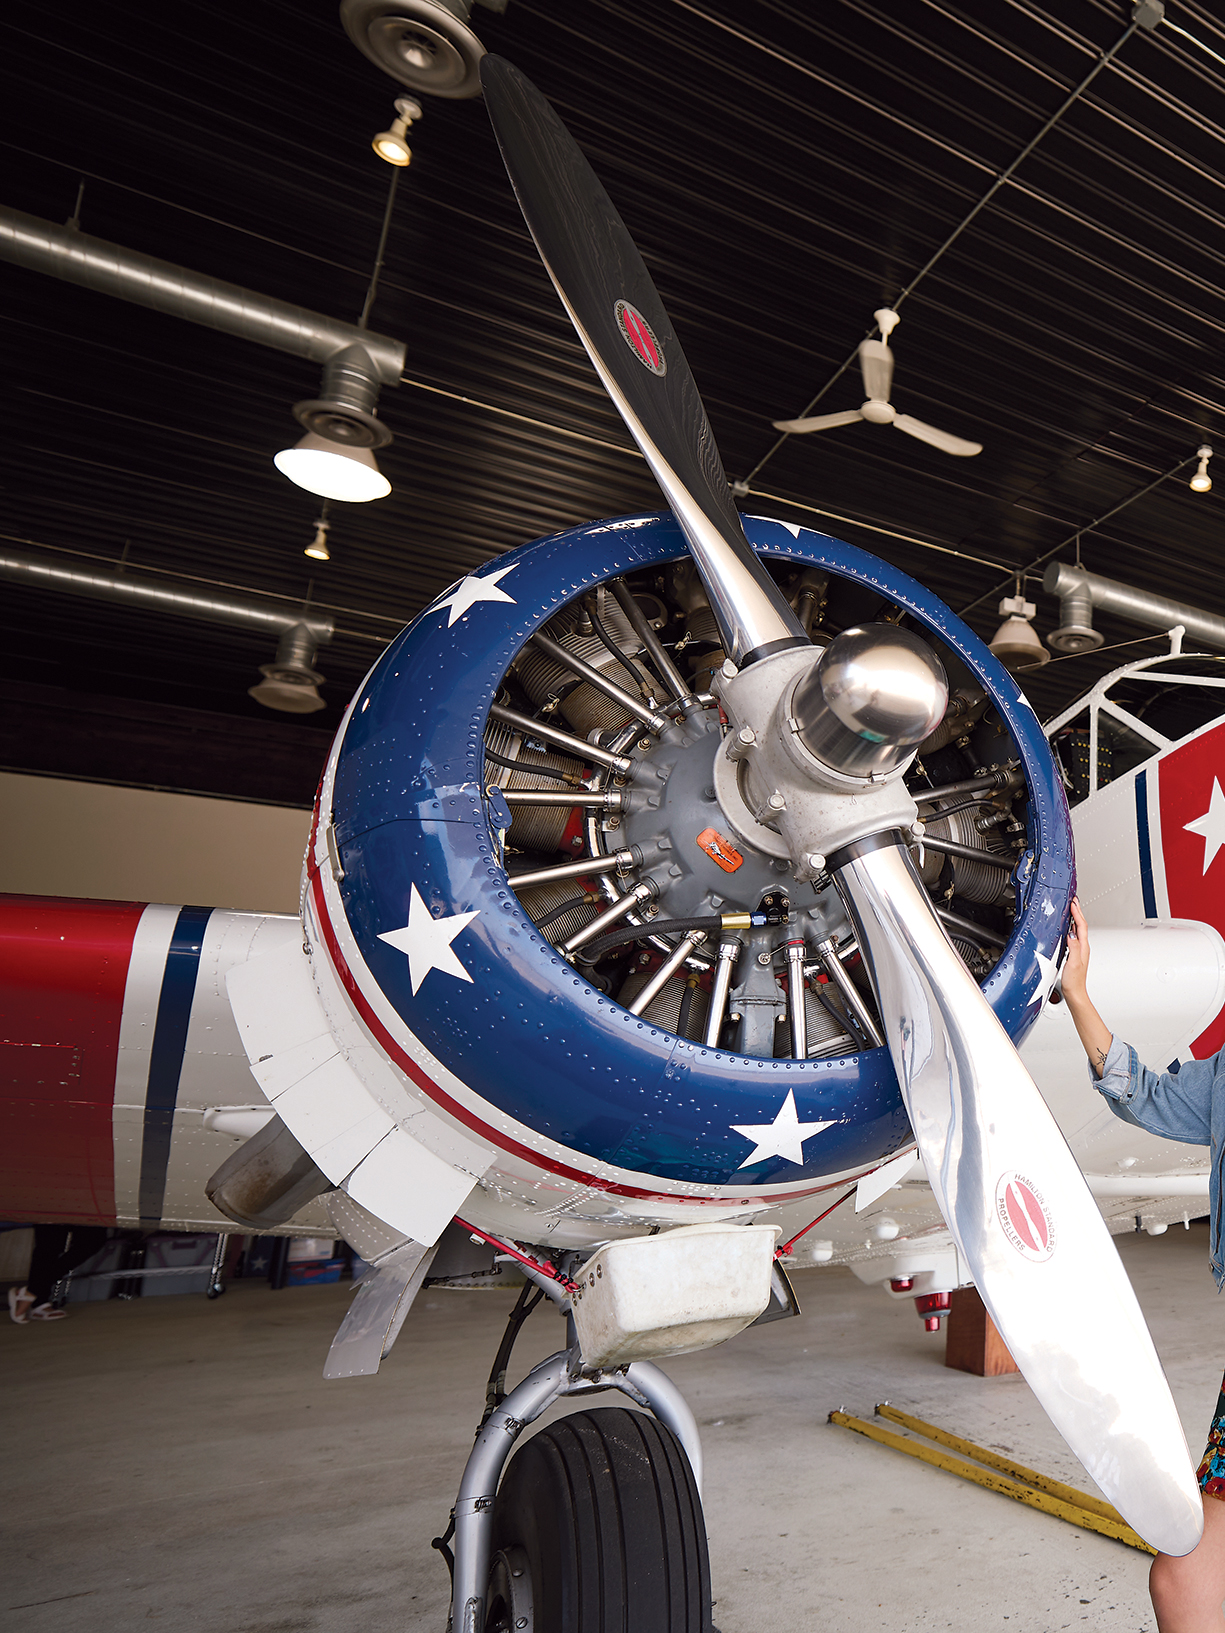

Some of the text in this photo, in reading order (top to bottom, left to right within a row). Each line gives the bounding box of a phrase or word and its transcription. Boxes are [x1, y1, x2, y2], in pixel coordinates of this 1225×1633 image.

[998, 1198, 1026, 1251] PROPELLERS
[1014, 1173, 1056, 1252] HAMILTON STANDARD
